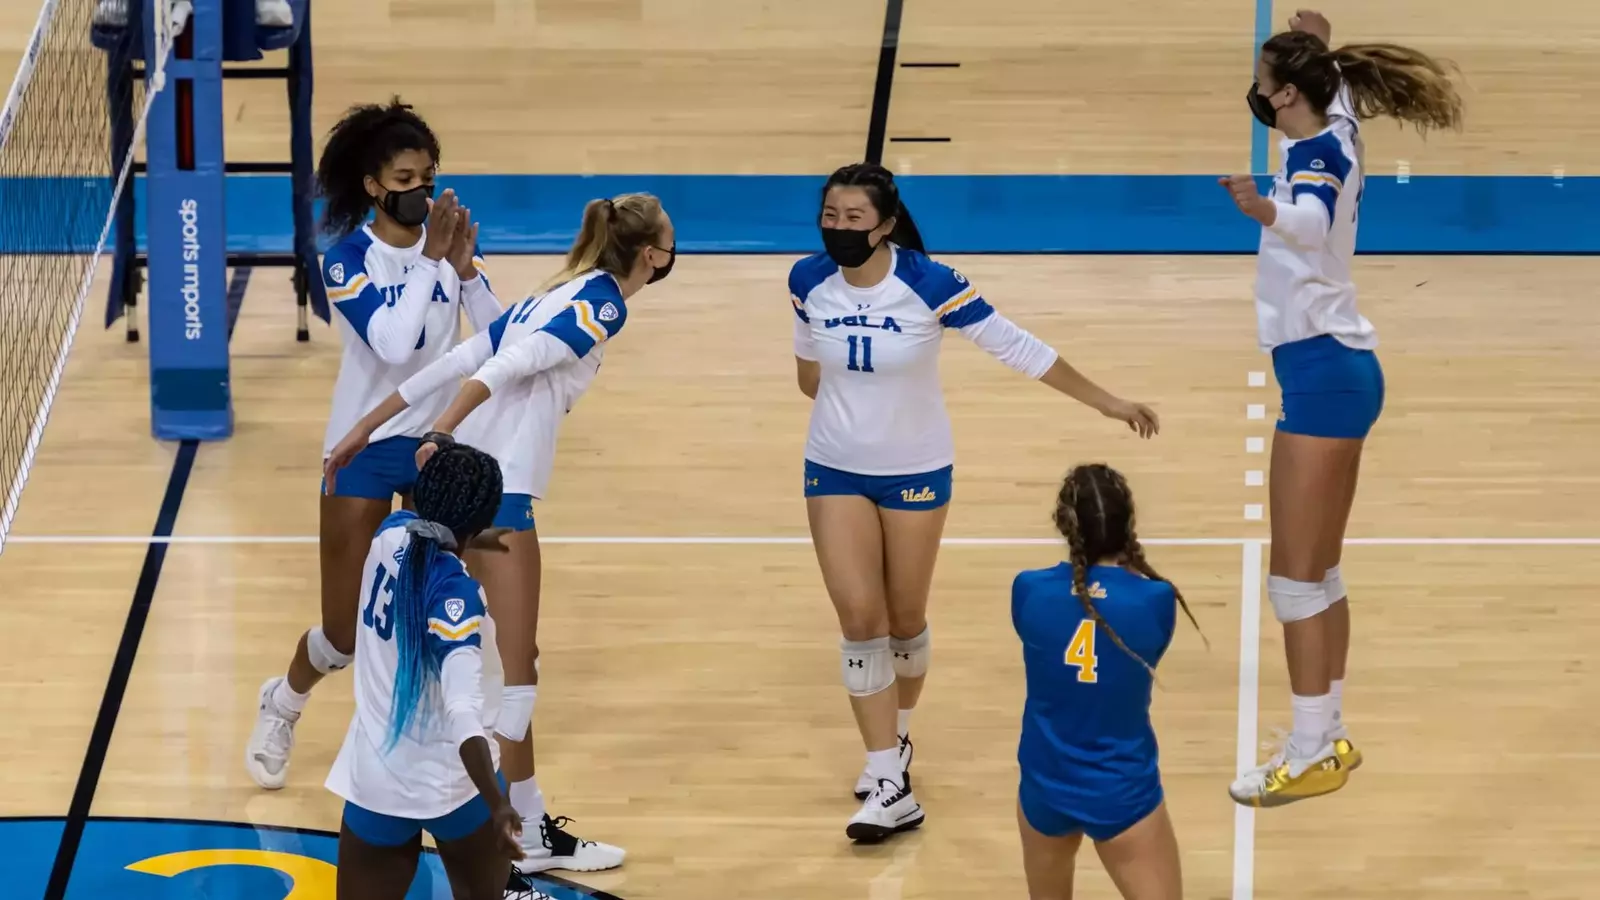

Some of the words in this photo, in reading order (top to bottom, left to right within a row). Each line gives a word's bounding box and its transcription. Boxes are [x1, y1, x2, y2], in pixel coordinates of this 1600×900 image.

[178, 198, 201, 262] sports
[180, 263, 203, 340] imports
[380, 280, 450, 308] UA
[847, 335, 875, 373] 11
[363, 561, 397, 642] 13
[1064, 619, 1098, 683] 4
